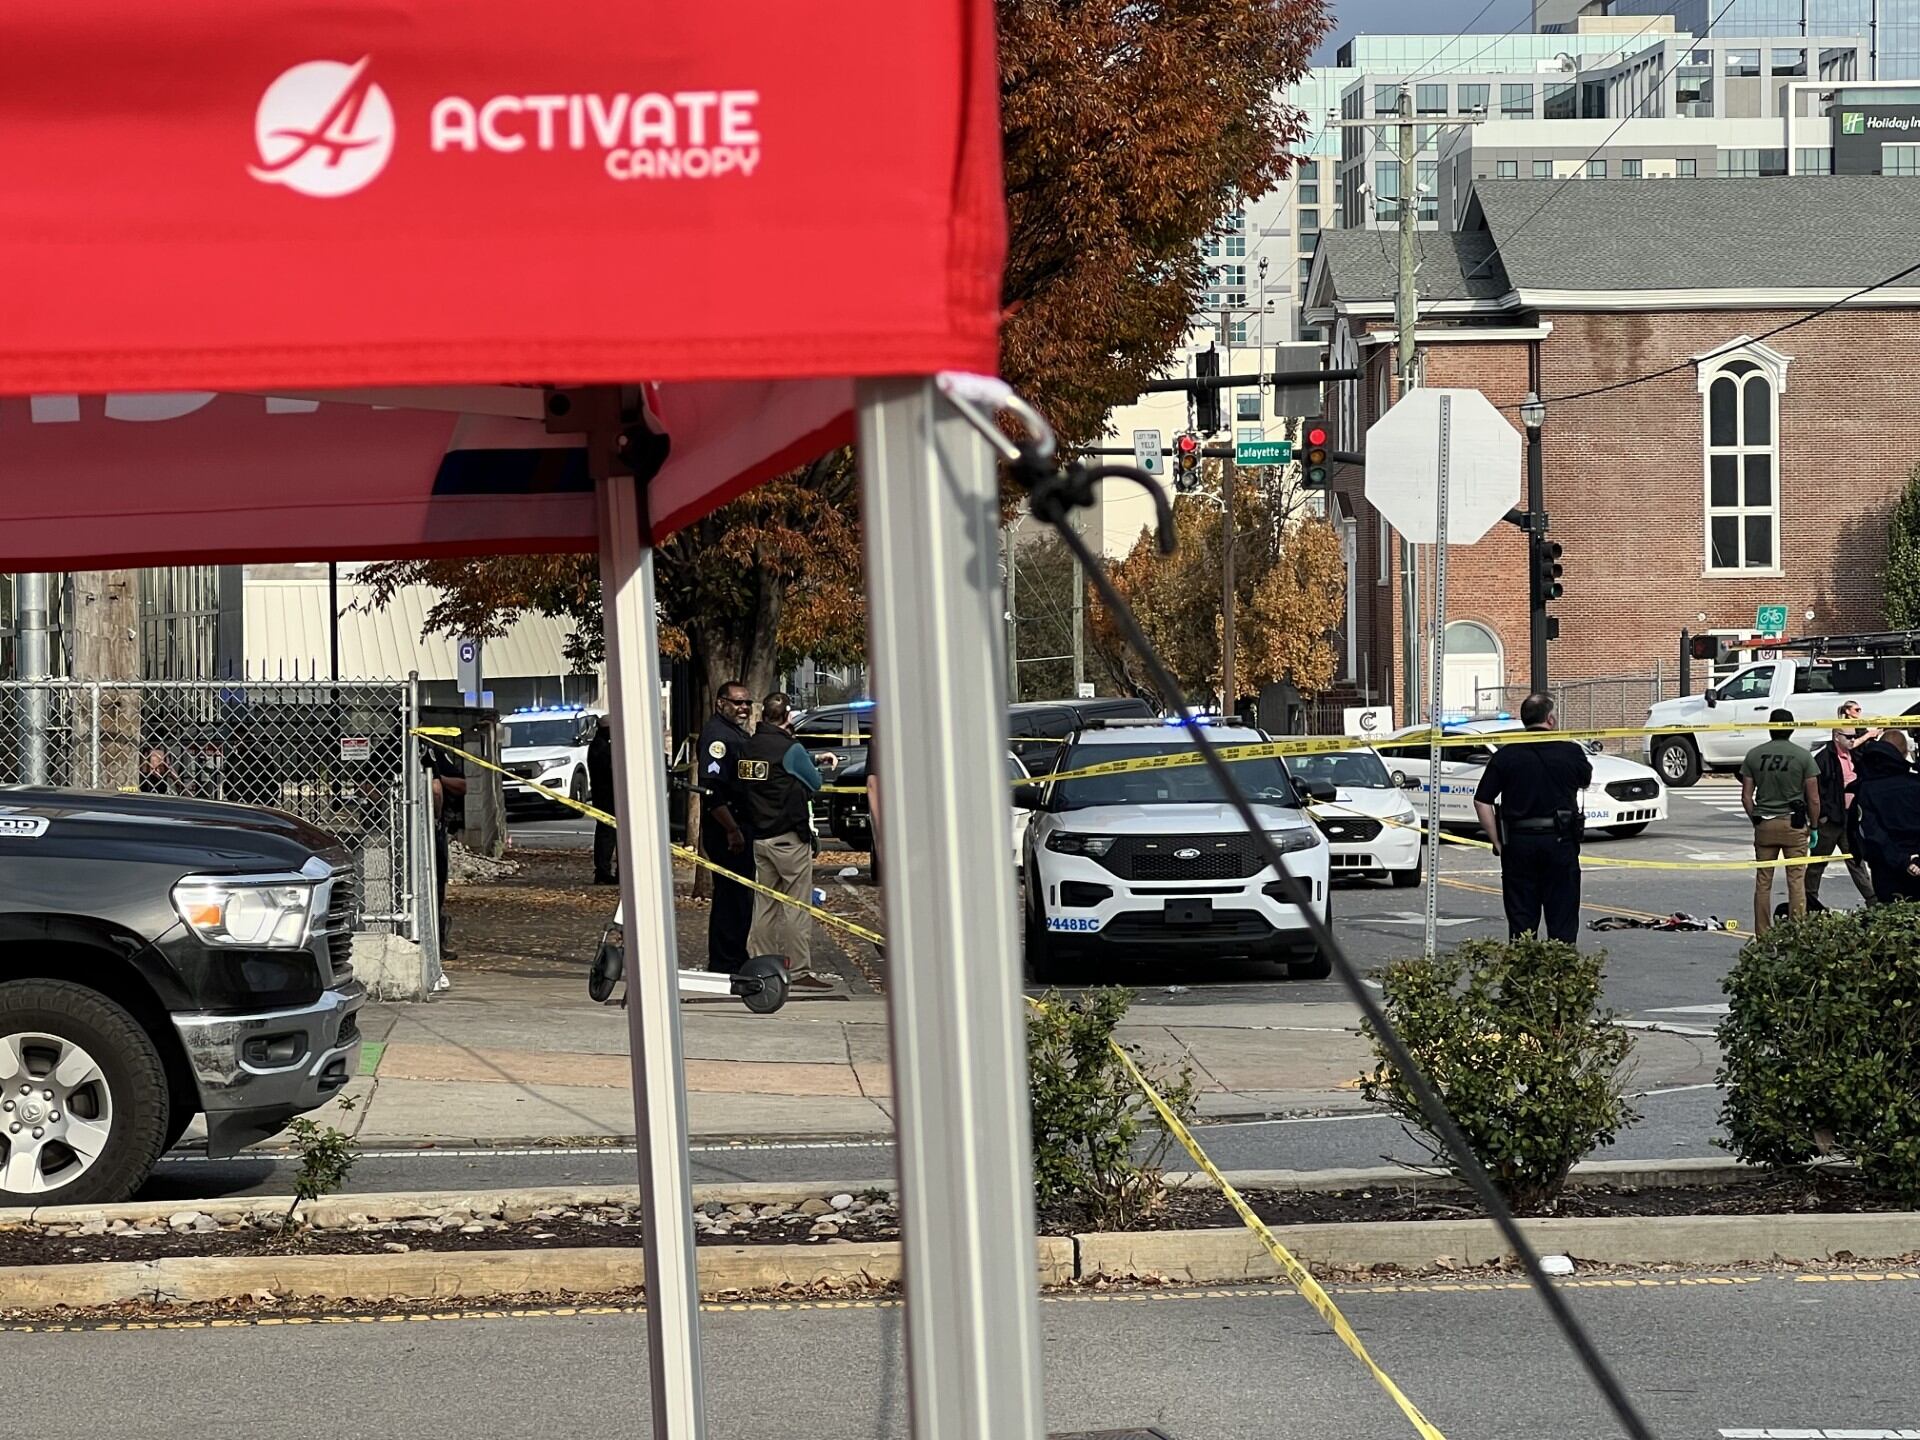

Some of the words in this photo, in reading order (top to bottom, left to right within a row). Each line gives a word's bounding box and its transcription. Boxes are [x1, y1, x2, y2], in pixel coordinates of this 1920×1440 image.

[430, 91, 760, 151] ACTIVATE
[1867, 116, 1909, 131] Holiday
[605, 147, 760, 180] CANOPY
[1238, 447, 1280, 460] Lafayette
[1759, 754, 1795, 772] TBI
[1450, 785, 1476, 794] POLIC
[1046, 917, 1100, 931] 9448BC
